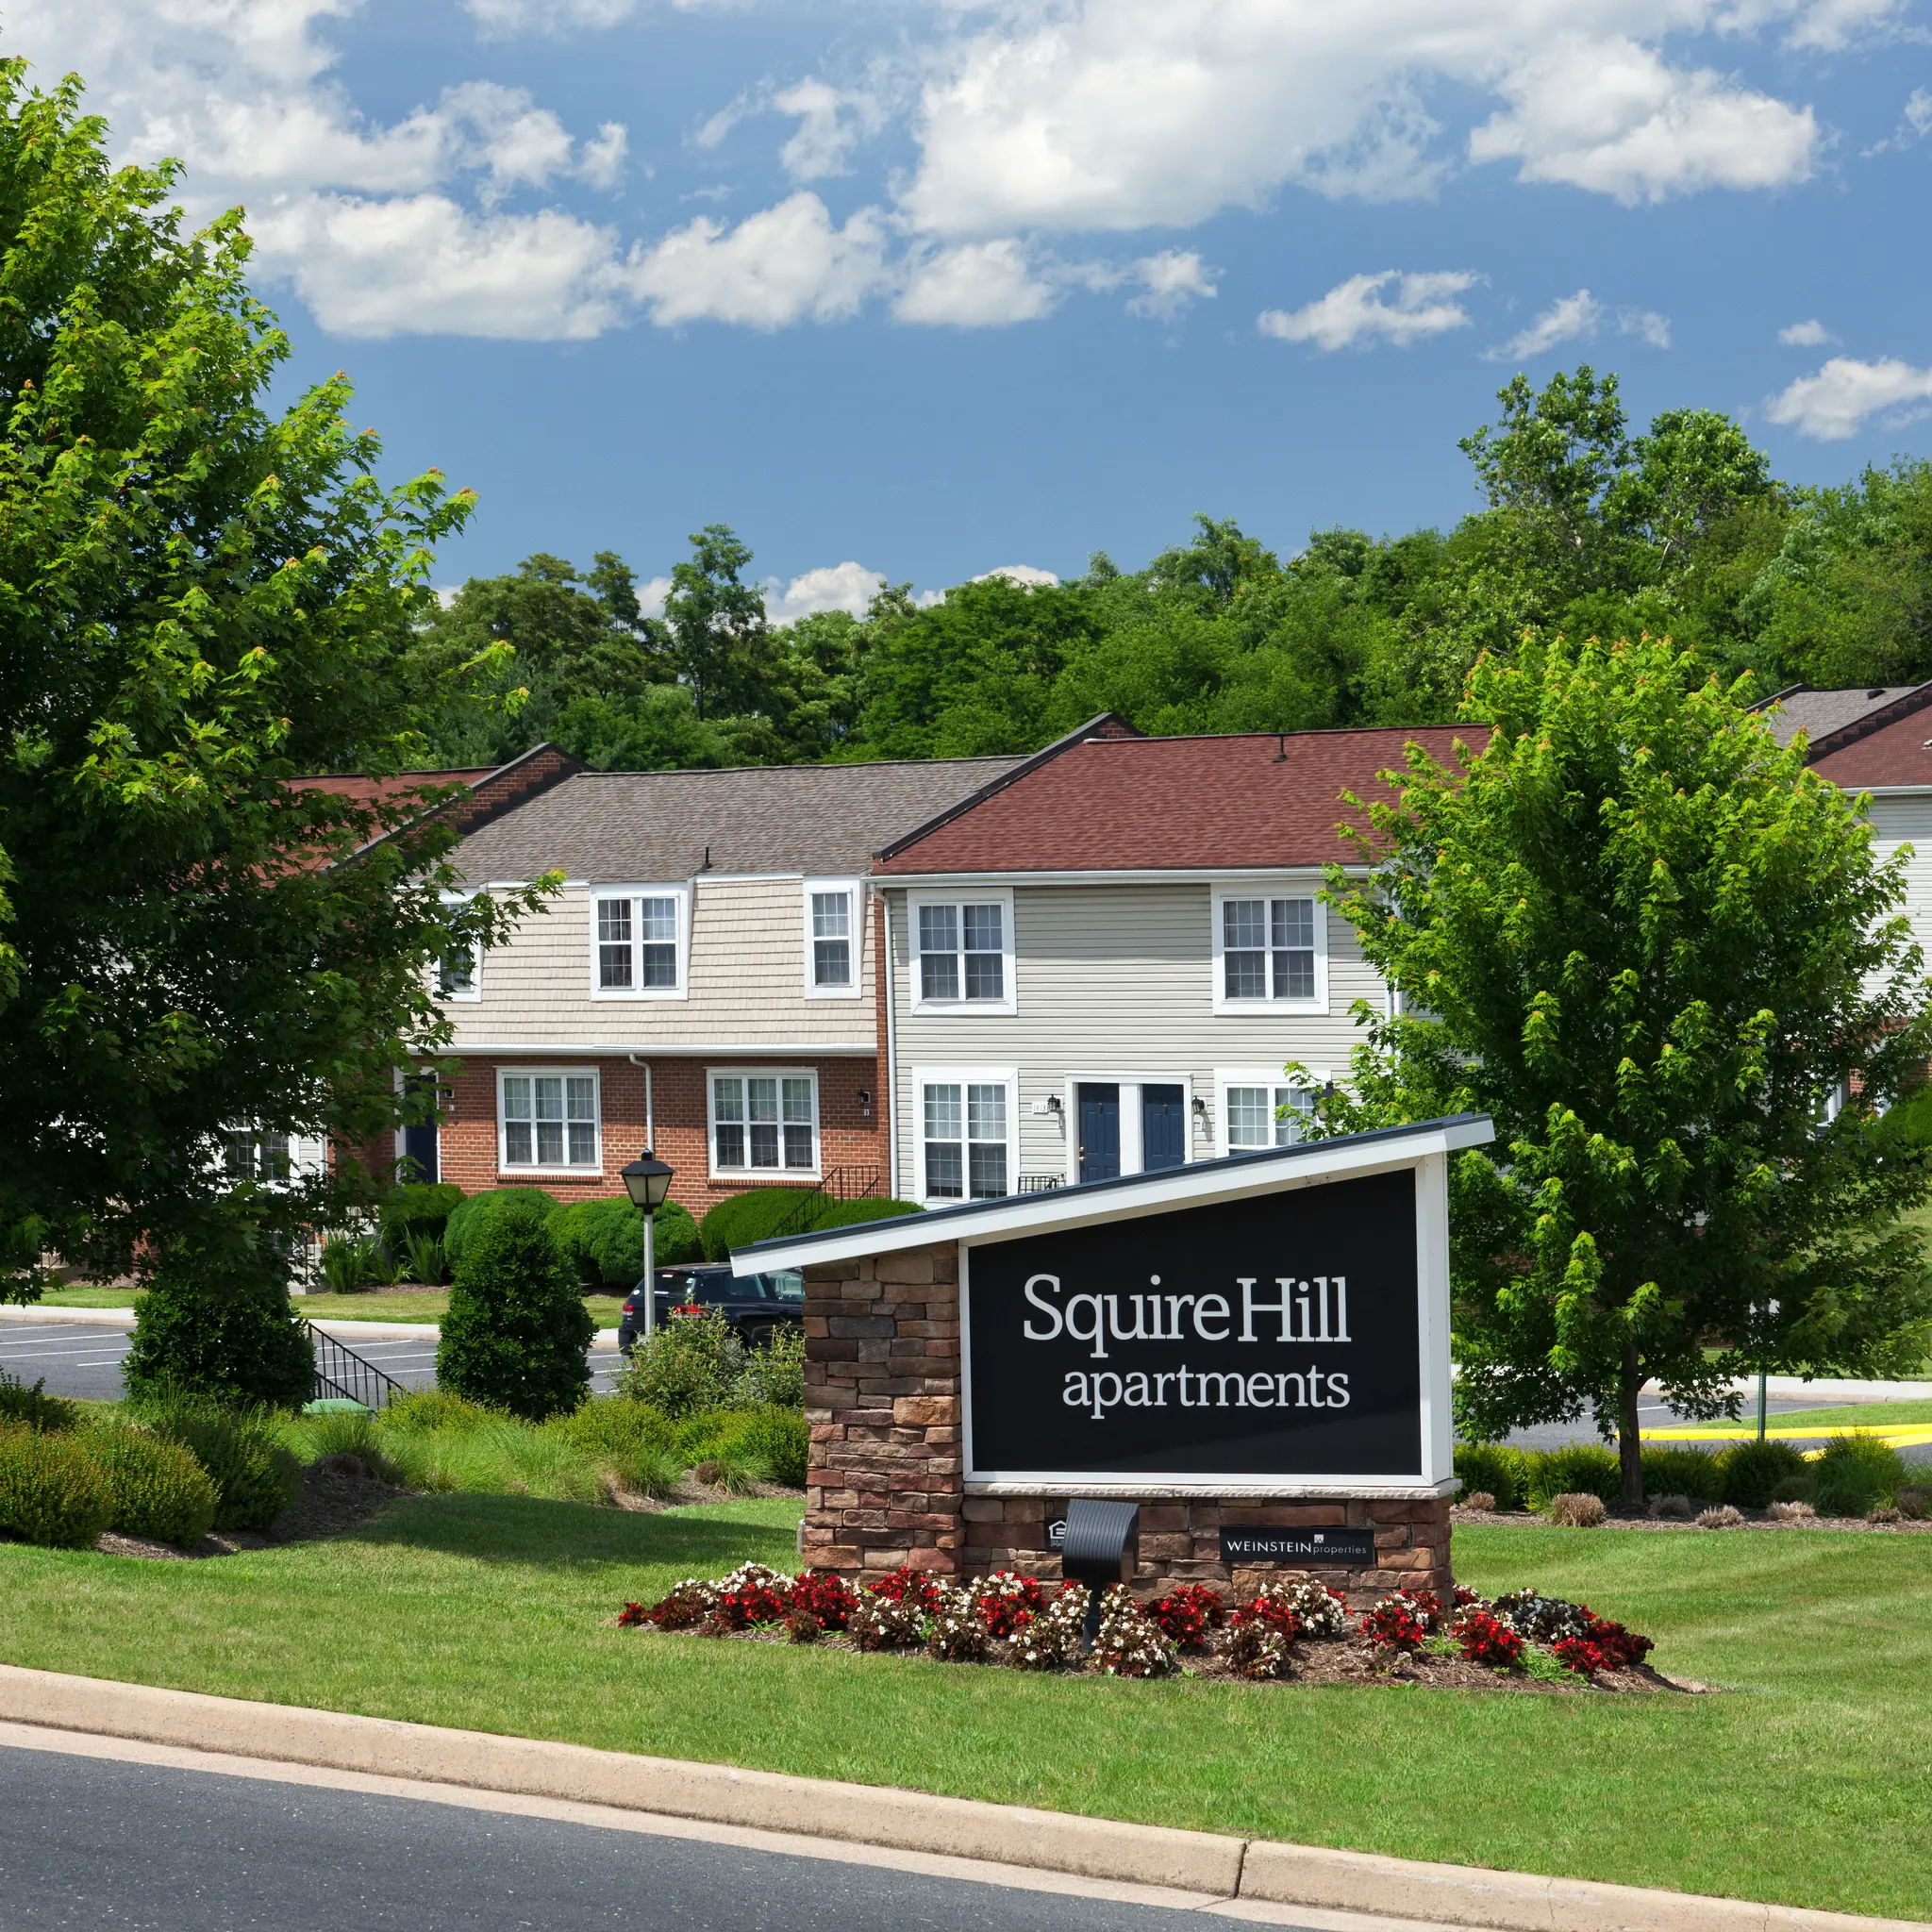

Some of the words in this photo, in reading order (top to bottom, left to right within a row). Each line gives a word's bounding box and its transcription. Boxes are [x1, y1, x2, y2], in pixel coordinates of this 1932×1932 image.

[1024, 1274, 1230, 1358] Squire
[1237, 1276, 1352, 1342] Hill
[1062, 1364, 1351, 1420] apartments
[1227, 1541, 1311, 1553] WEINSTEIN
[1313, 1544, 1367, 1556] properties
